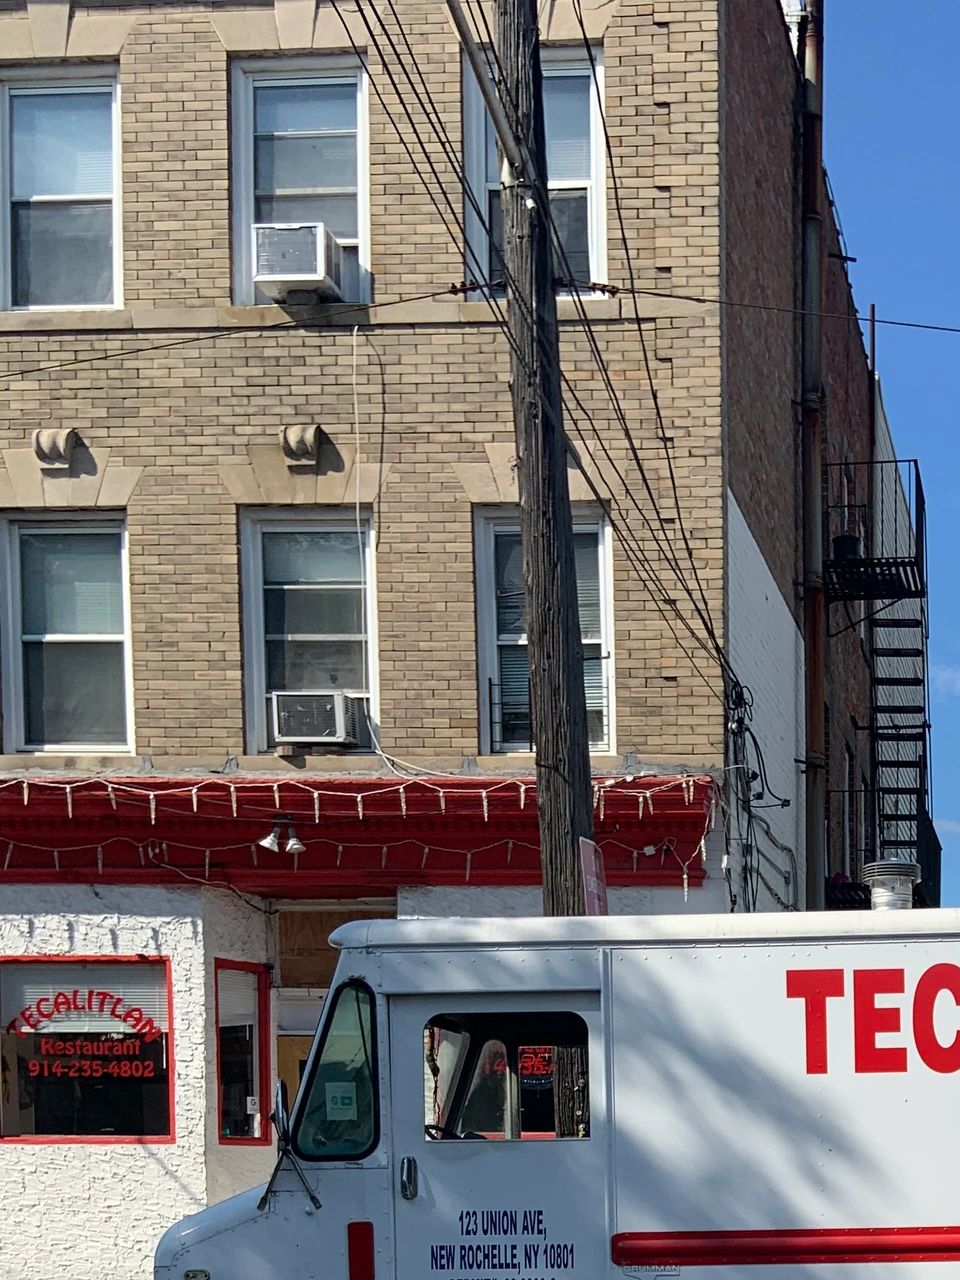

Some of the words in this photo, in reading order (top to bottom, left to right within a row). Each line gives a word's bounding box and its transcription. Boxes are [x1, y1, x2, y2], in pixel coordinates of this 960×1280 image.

[6, 990, 161, 1043] TECALITLAN
[41, 1037, 141, 1056] Restaurant
[28, 1060, 155, 1077] 914-235-4802
[459, 1210, 478, 1236] 123
[482, 1210, 517, 1235] UNION
[522, 1210, 547, 1241] AVE,
[431, 1245, 455, 1270] NEW
[460, 1244, 520, 1275] ROCHELLE,
[524, 1244, 539, 1269] NY
[543, 1243, 574, 1269] 10801
